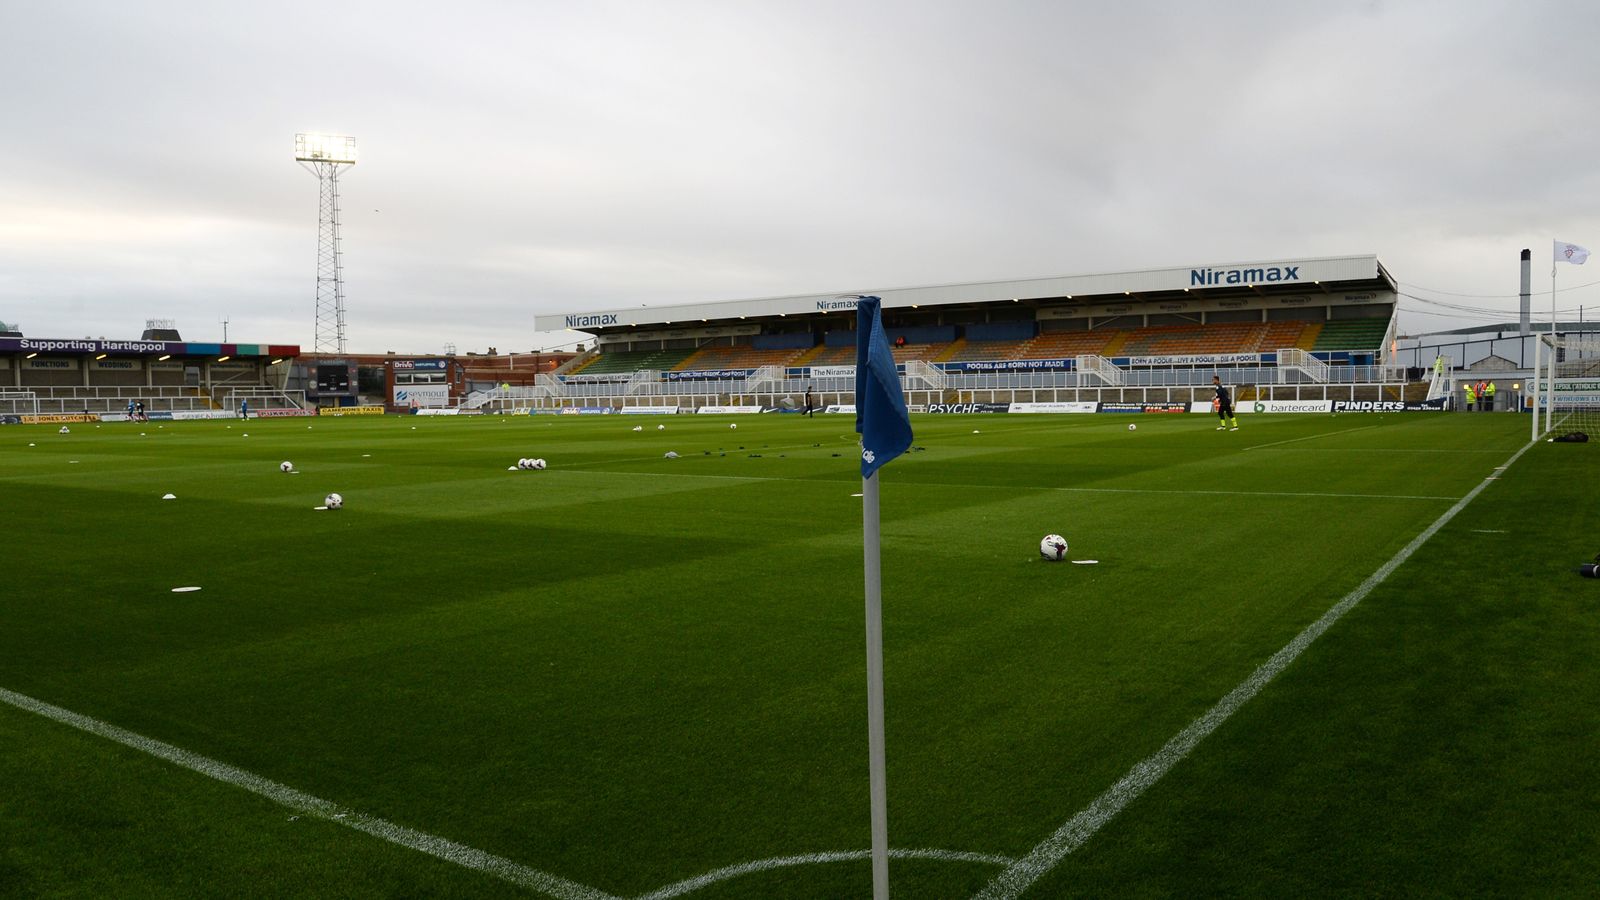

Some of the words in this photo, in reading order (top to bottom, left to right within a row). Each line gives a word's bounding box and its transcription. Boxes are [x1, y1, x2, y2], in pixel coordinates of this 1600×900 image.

[1190, 266, 1299, 285] Niramax
[816, 300, 858, 310] Niramax
[565, 314, 617, 327] Niramax
[20, 339, 96, 352] Supporting
[101, 341, 166, 352] Hartlepool
[31, 360, 70, 368] FUNCTIONS
[98, 360, 132, 368] WEDDINGS
[1334, 401, 1405, 410] PINDER'S
